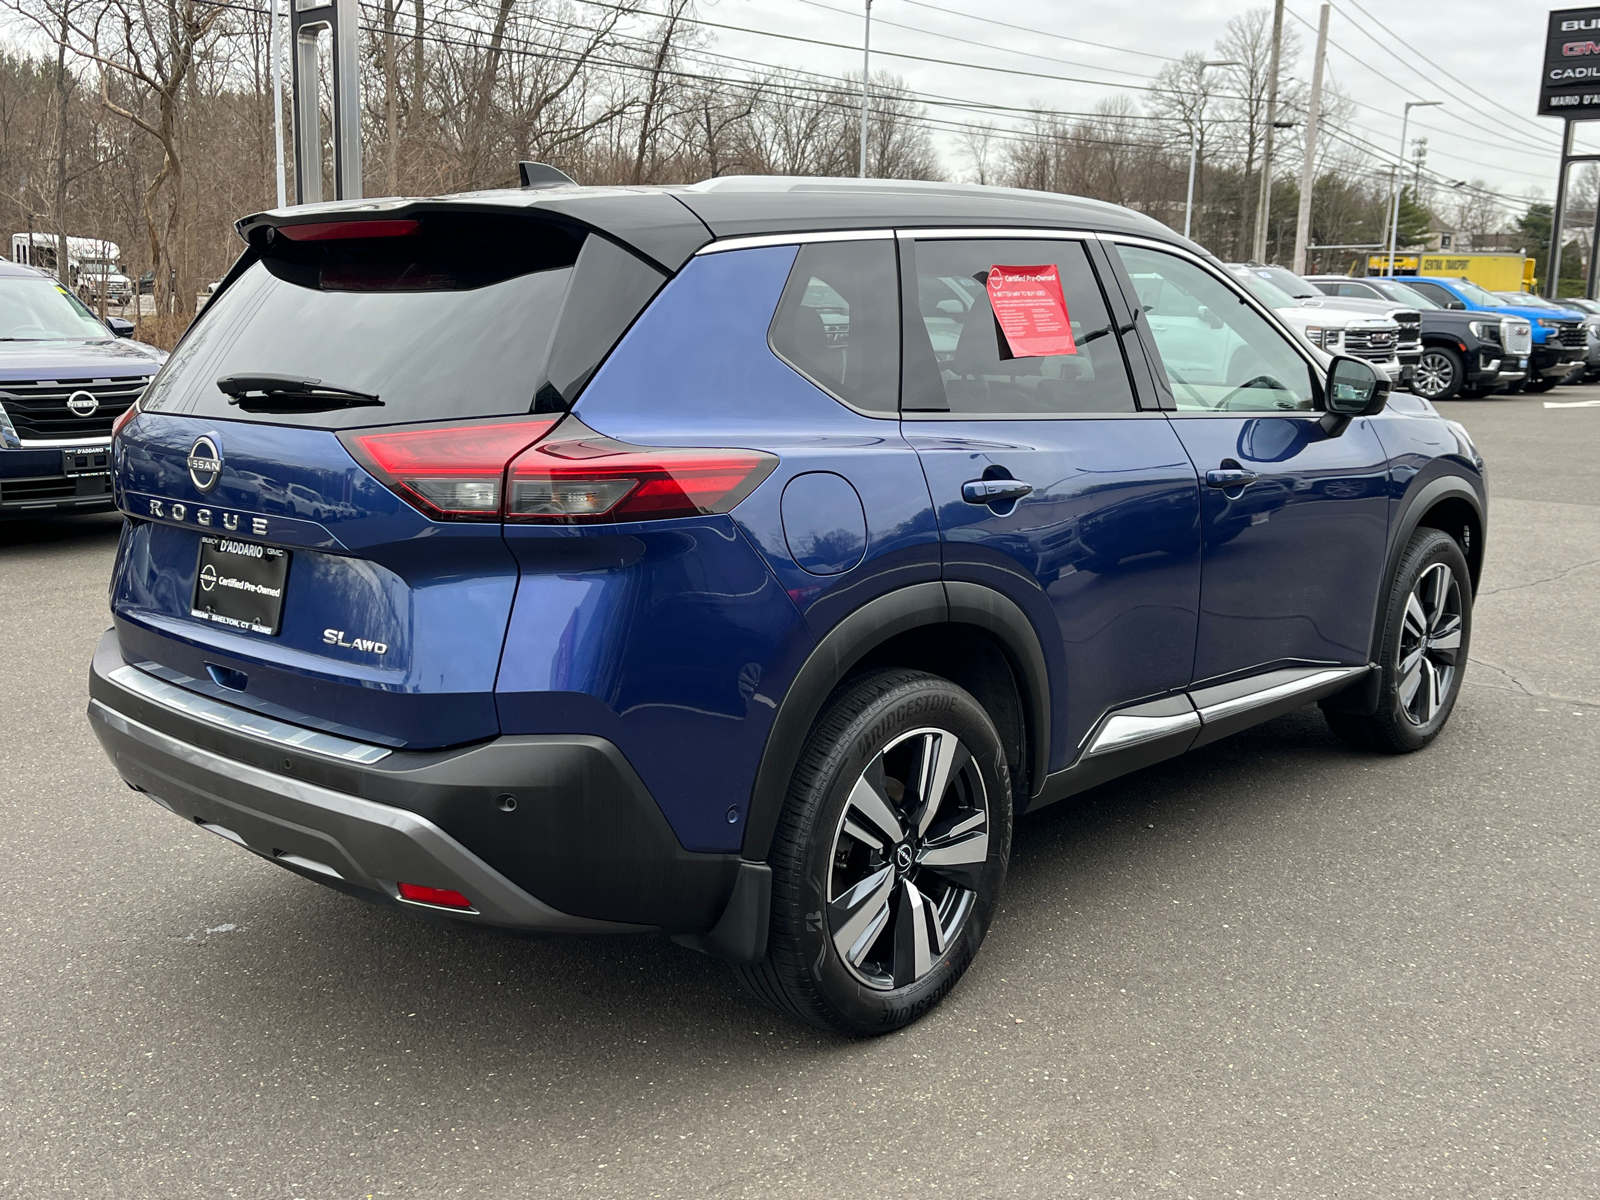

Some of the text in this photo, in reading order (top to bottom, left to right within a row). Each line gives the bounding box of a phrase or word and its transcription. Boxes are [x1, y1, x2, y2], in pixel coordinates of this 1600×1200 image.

[1549, 66, 1600, 80] CADIL
[1549, 95, 1580, 106] MARIO
[1423, 259, 1471, 271] CENTRAL TRANSPORT
[1004, 274, 1026, 282] Certified
[1026, 273, 1056, 282] Pre-Owned
[189, 458, 220, 471] ISSAN
[149, 499, 269, 536] ROGUE
[201, 536, 284, 558] BUICK D'ADDARIO GMC
[200, 573, 217, 582] NISSAN
[218, 576, 281, 598] Certified Pre-Owned
[211, 613, 240, 628] SHELTON,
[240, 621, 250, 630] CT
[856, 693, 959, 761] BRIDGESTONE
